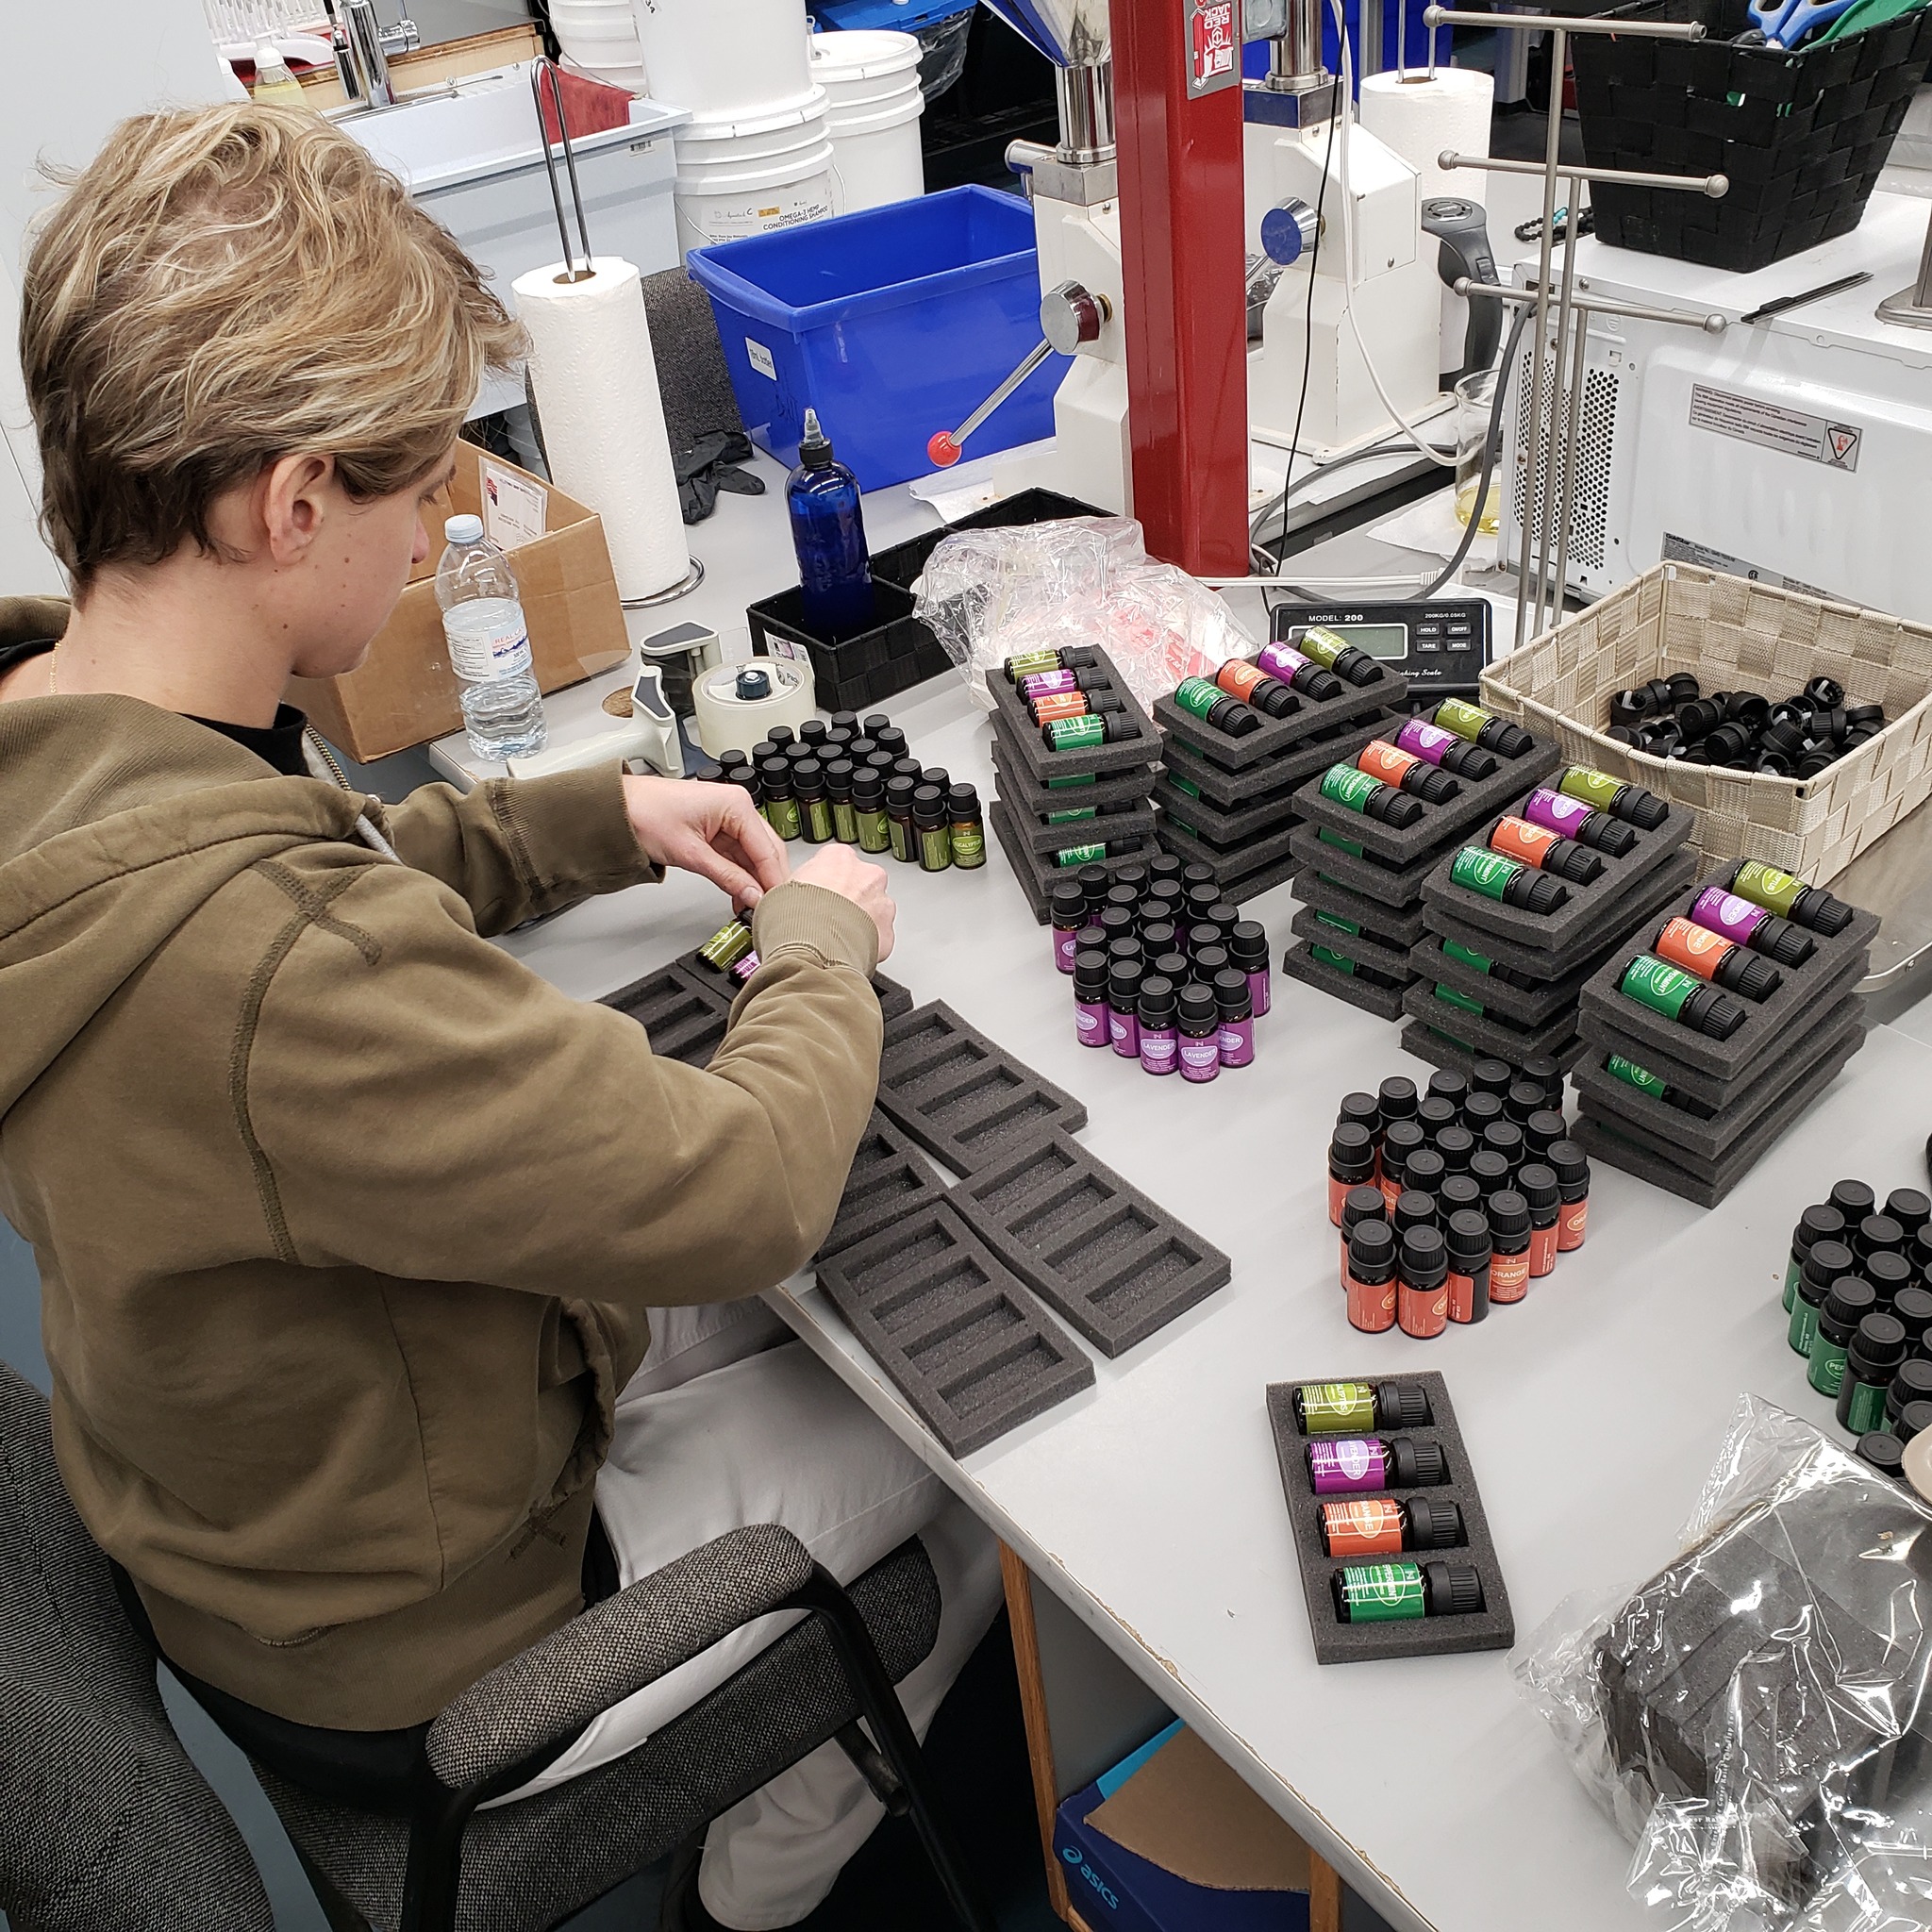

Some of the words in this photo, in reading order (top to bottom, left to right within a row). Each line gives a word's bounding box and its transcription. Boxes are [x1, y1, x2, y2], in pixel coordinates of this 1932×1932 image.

[1205, 3, 1231, 17] JACK
[1204, 14, 1230, 29] RED
[762, 216, 808, 230] CONDITIONING
[808, 205, 828, 220] SHAMPOO
[779, 208, 807, 222] OMEGA-3
[807, 204, 820, 213] HEMP
[1421, 668, 1442, 676] Scale
[1142, 1041, 1175, 1051] LAVENDER
[1184, 1048, 1216, 1058] LAVENDER
[1491, 1267, 1525, 1278] ORANGE
[1360, 1500, 1374, 1531] RANGE
[1080, 1863, 1120, 1910] asics
